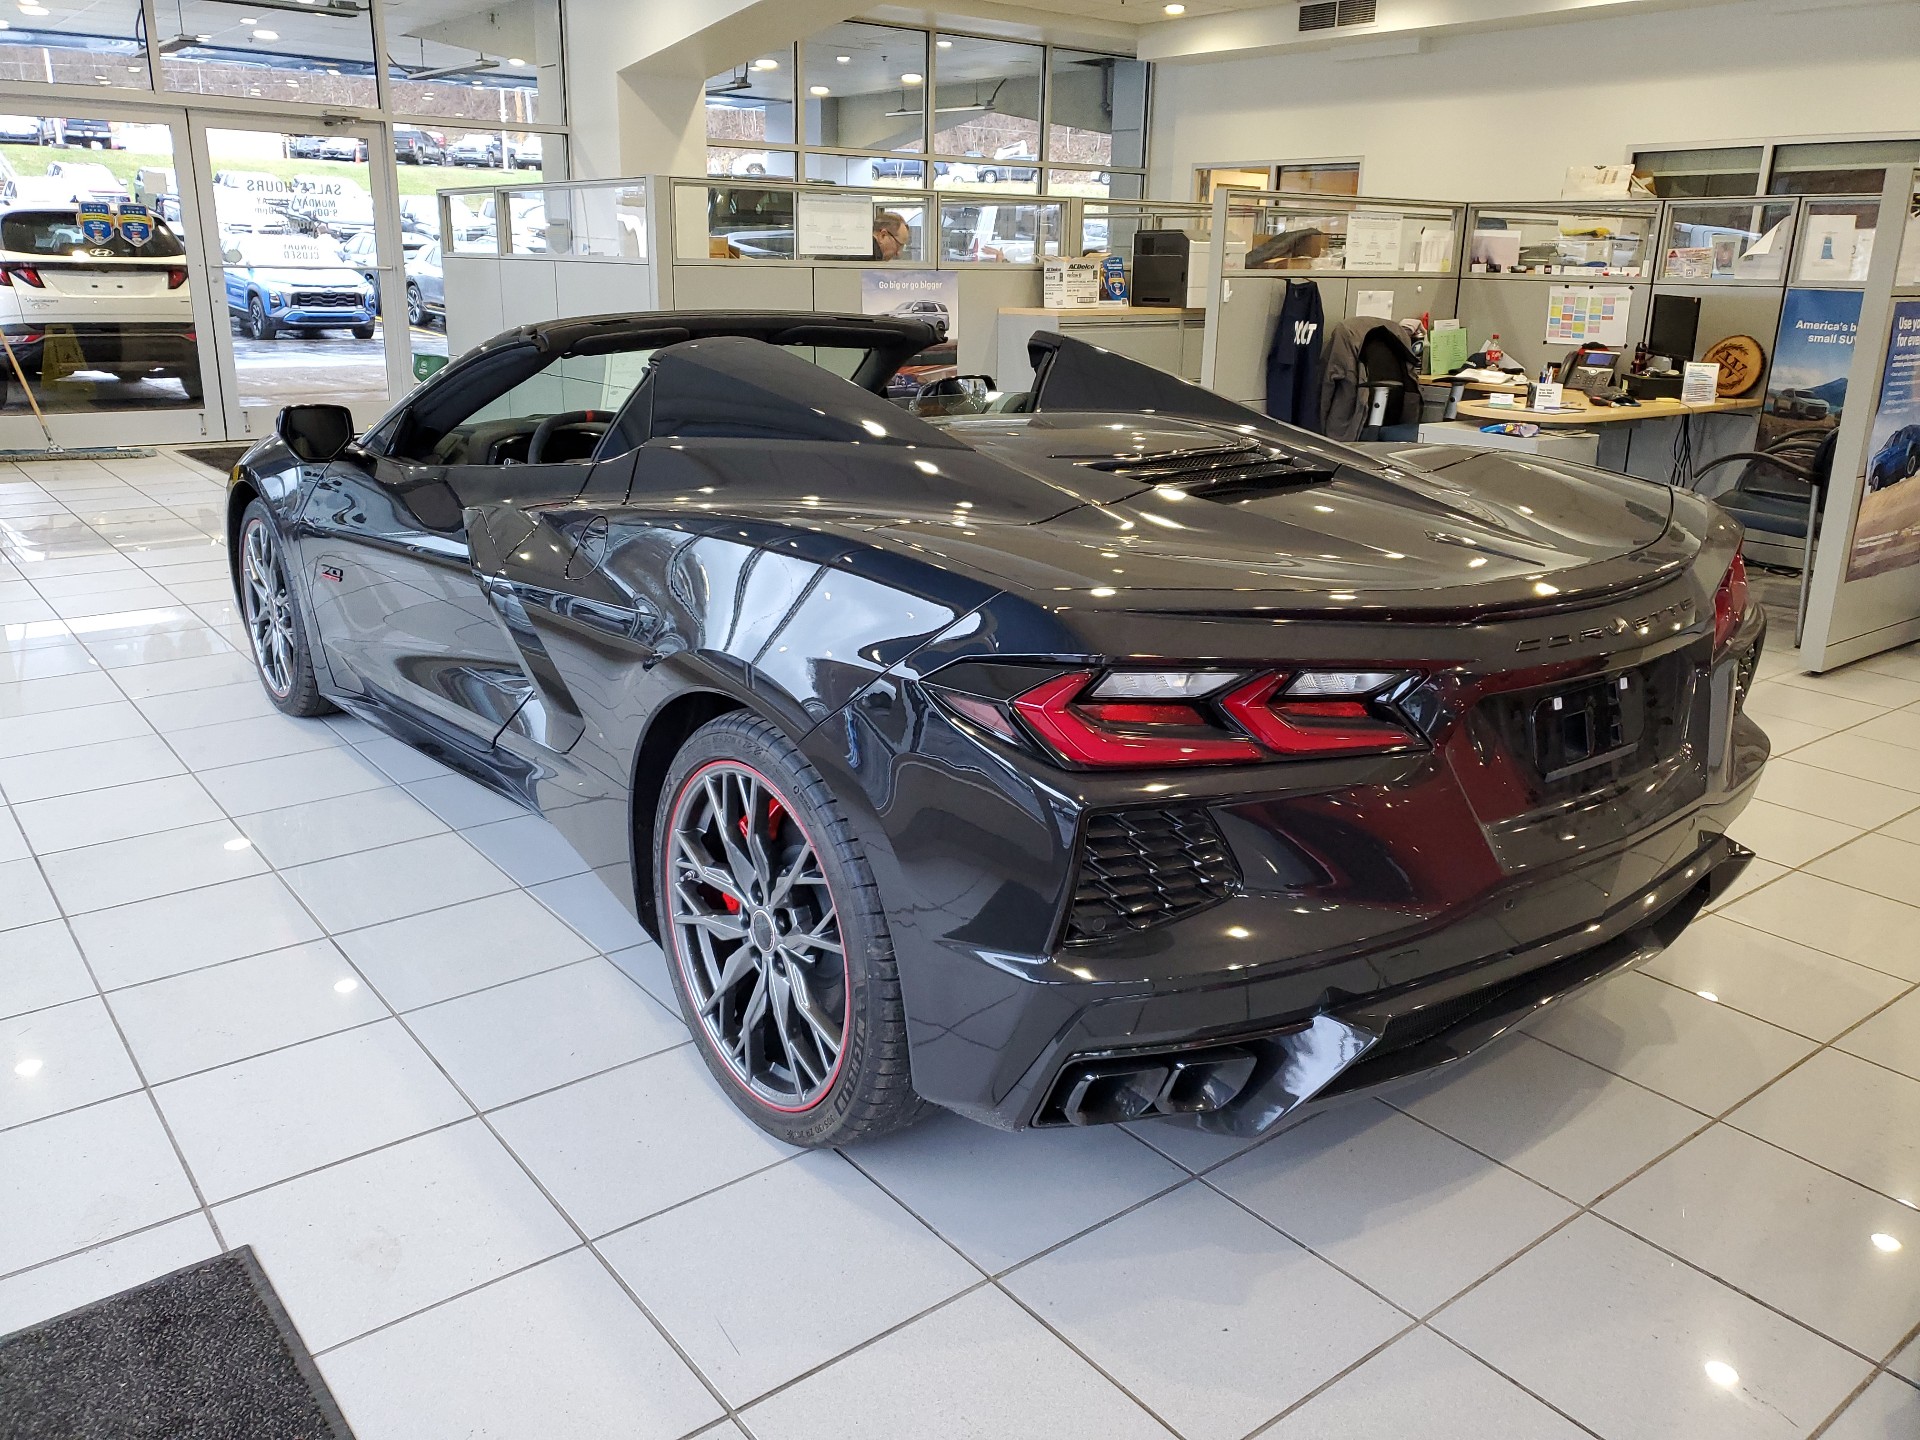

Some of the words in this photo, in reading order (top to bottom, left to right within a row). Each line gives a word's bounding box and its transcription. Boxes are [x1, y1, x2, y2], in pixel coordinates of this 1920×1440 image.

[879, 281, 889, 289] Go
[889, 280, 901, 291] big
[901, 281, 909, 289] or
[909, 282, 919, 291] go
[920, 280, 943, 291] bigger
[1795, 320, 1848, 332] America's
[1898, 316, 1912, 330] Use
[1807, 334, 1837, 344] small
[1896, 333, 1908, 347] for
[1514, 597, 1695, 652] CORVETTE
